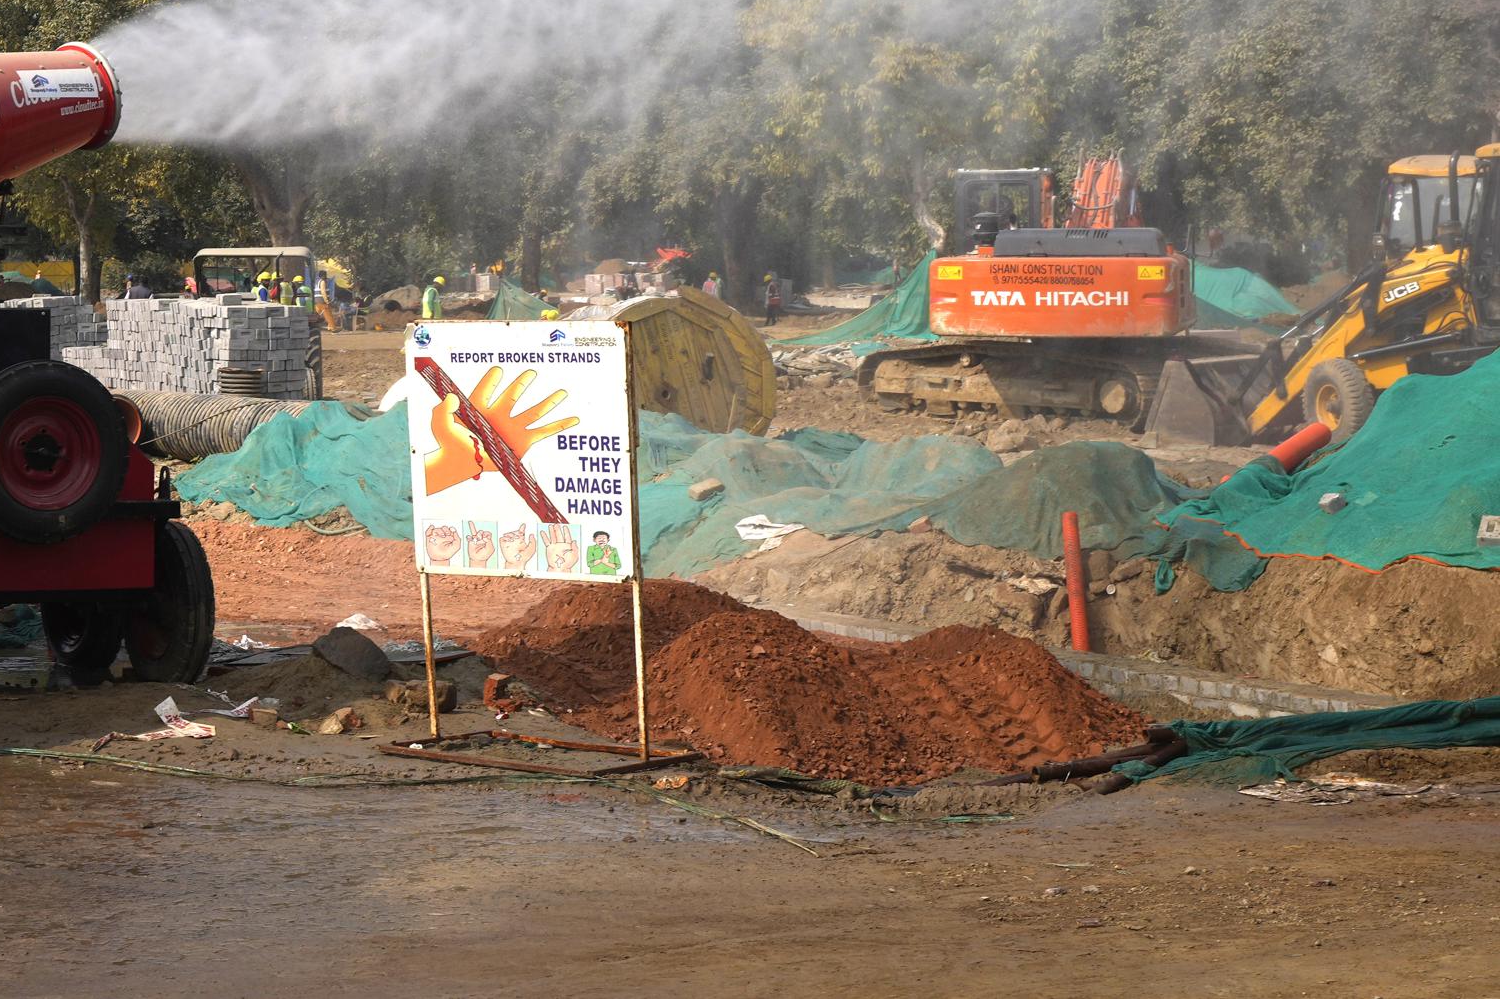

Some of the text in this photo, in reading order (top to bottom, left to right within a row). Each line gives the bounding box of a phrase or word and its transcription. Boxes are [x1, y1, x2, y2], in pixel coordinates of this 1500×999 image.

[989, 264, 1103, 276] ISHANI CONSTRUCTION
[971, 291, 1129, 306] TATA HITACHI
[1384, 281, 1420, 303] JCB
[450, 352, 601, 363] REPORT BROKEN STRANDS
[557, 435, 621, 452] BEFORE
[579, 456, 621, 473] THEY
[555, 477, 622, 494] DAMAGE
[568, 498, 622, 516] HANDS
